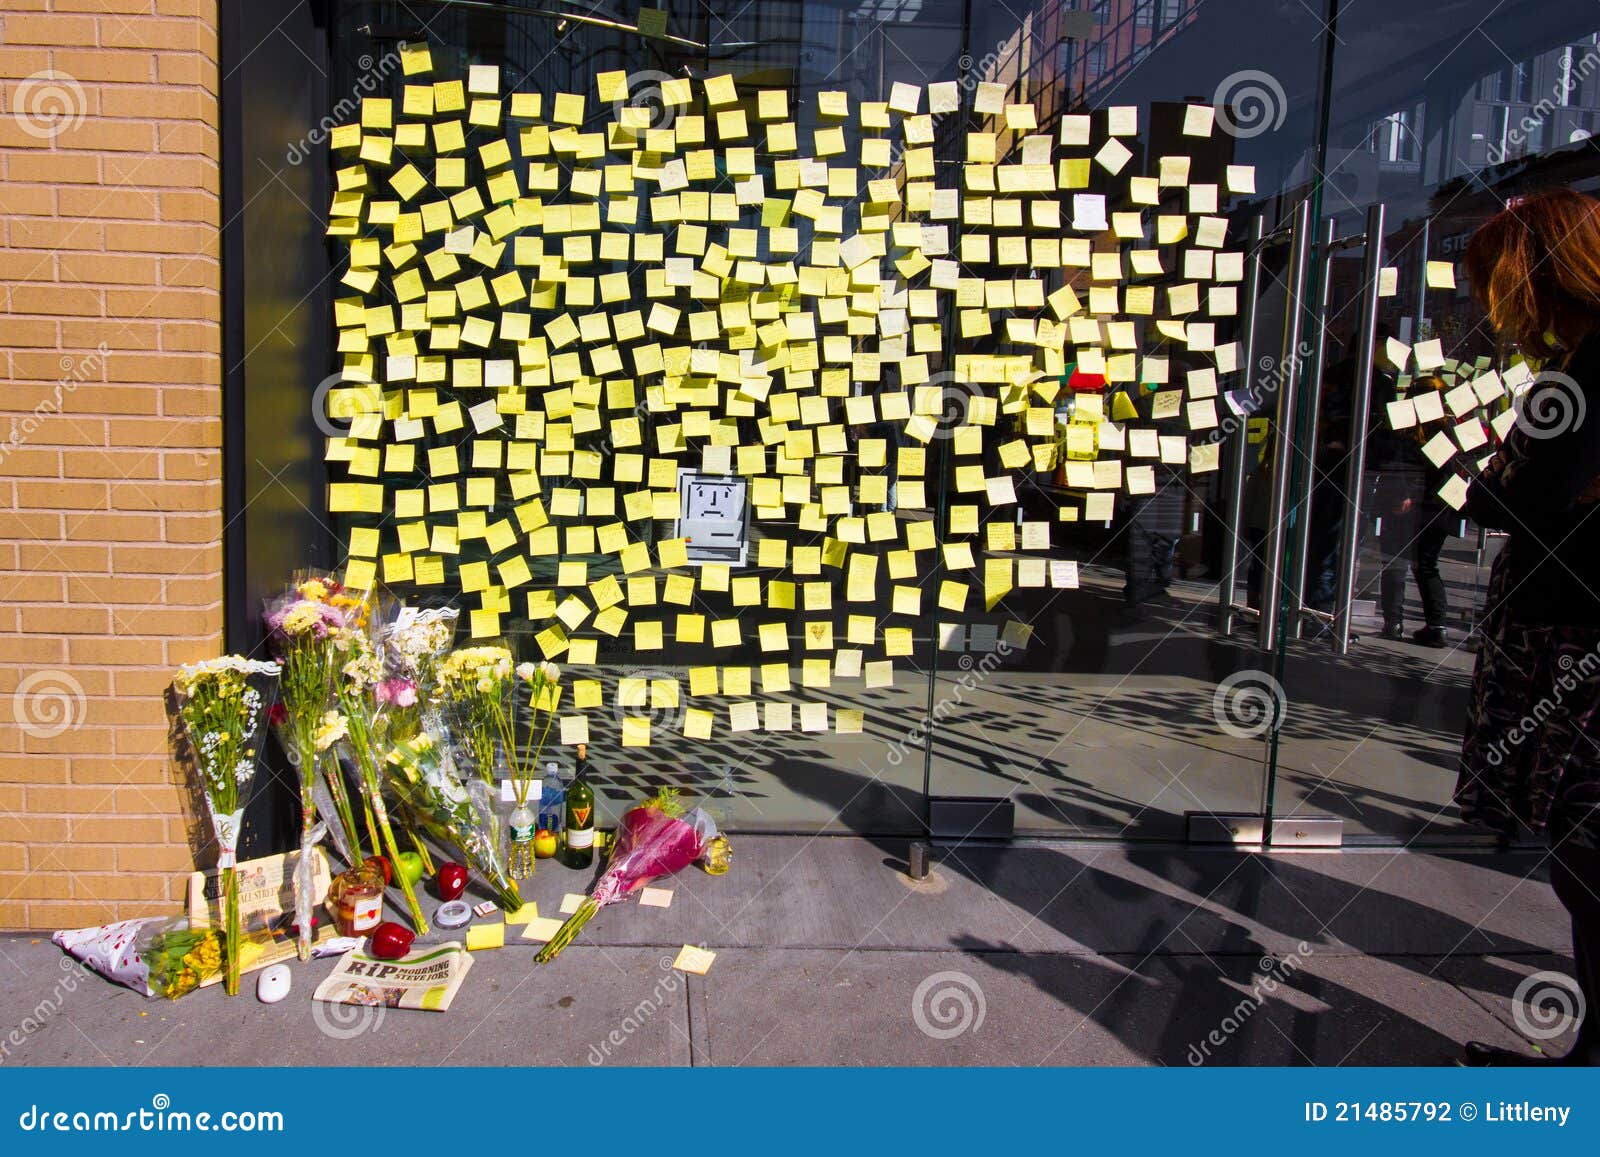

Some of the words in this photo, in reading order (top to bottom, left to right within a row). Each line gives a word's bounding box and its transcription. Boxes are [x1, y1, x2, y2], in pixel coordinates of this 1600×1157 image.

[399, 960, 450, 975] MOURNING
[394, 973, 426, 982] STEVE
[426, 970, 450, 981] JOBS
